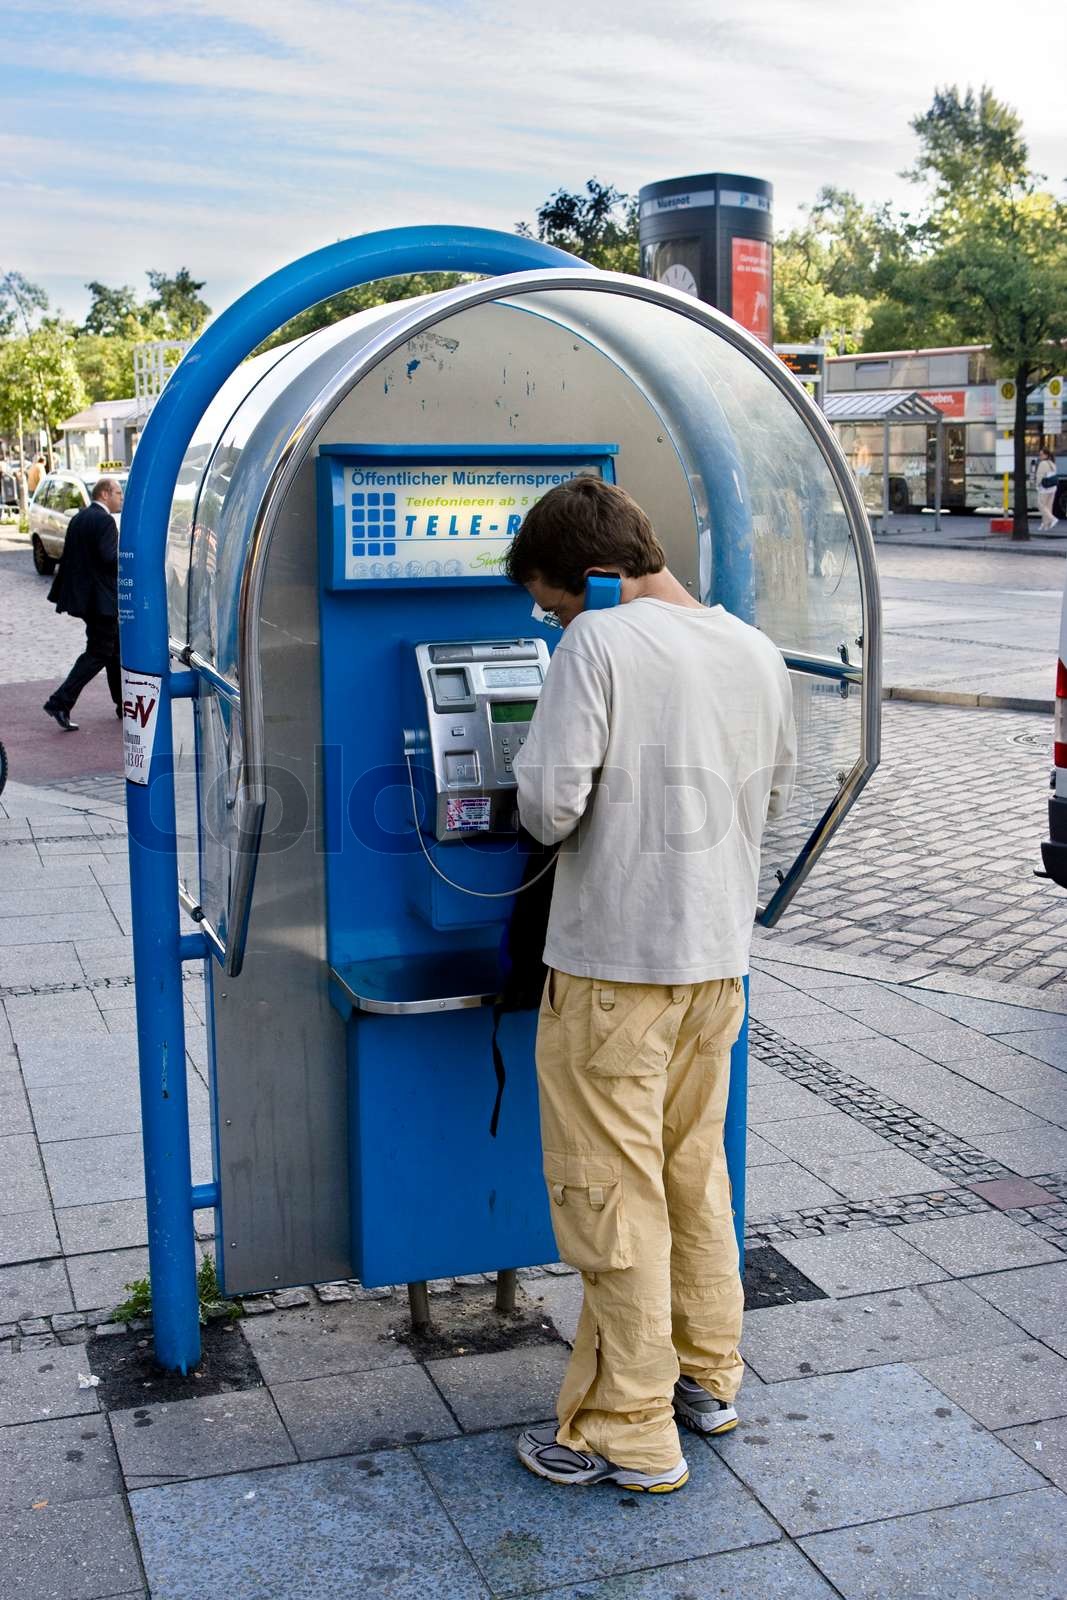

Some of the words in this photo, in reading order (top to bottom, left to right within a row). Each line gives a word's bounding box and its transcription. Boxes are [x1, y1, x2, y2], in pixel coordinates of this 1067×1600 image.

[351, 468, 448, 486] Öffentlicher
[405, 496, 494, 507] Telefonieren
[499, 496, 516, 506] ab
[521, 496, 529, 506] 5
